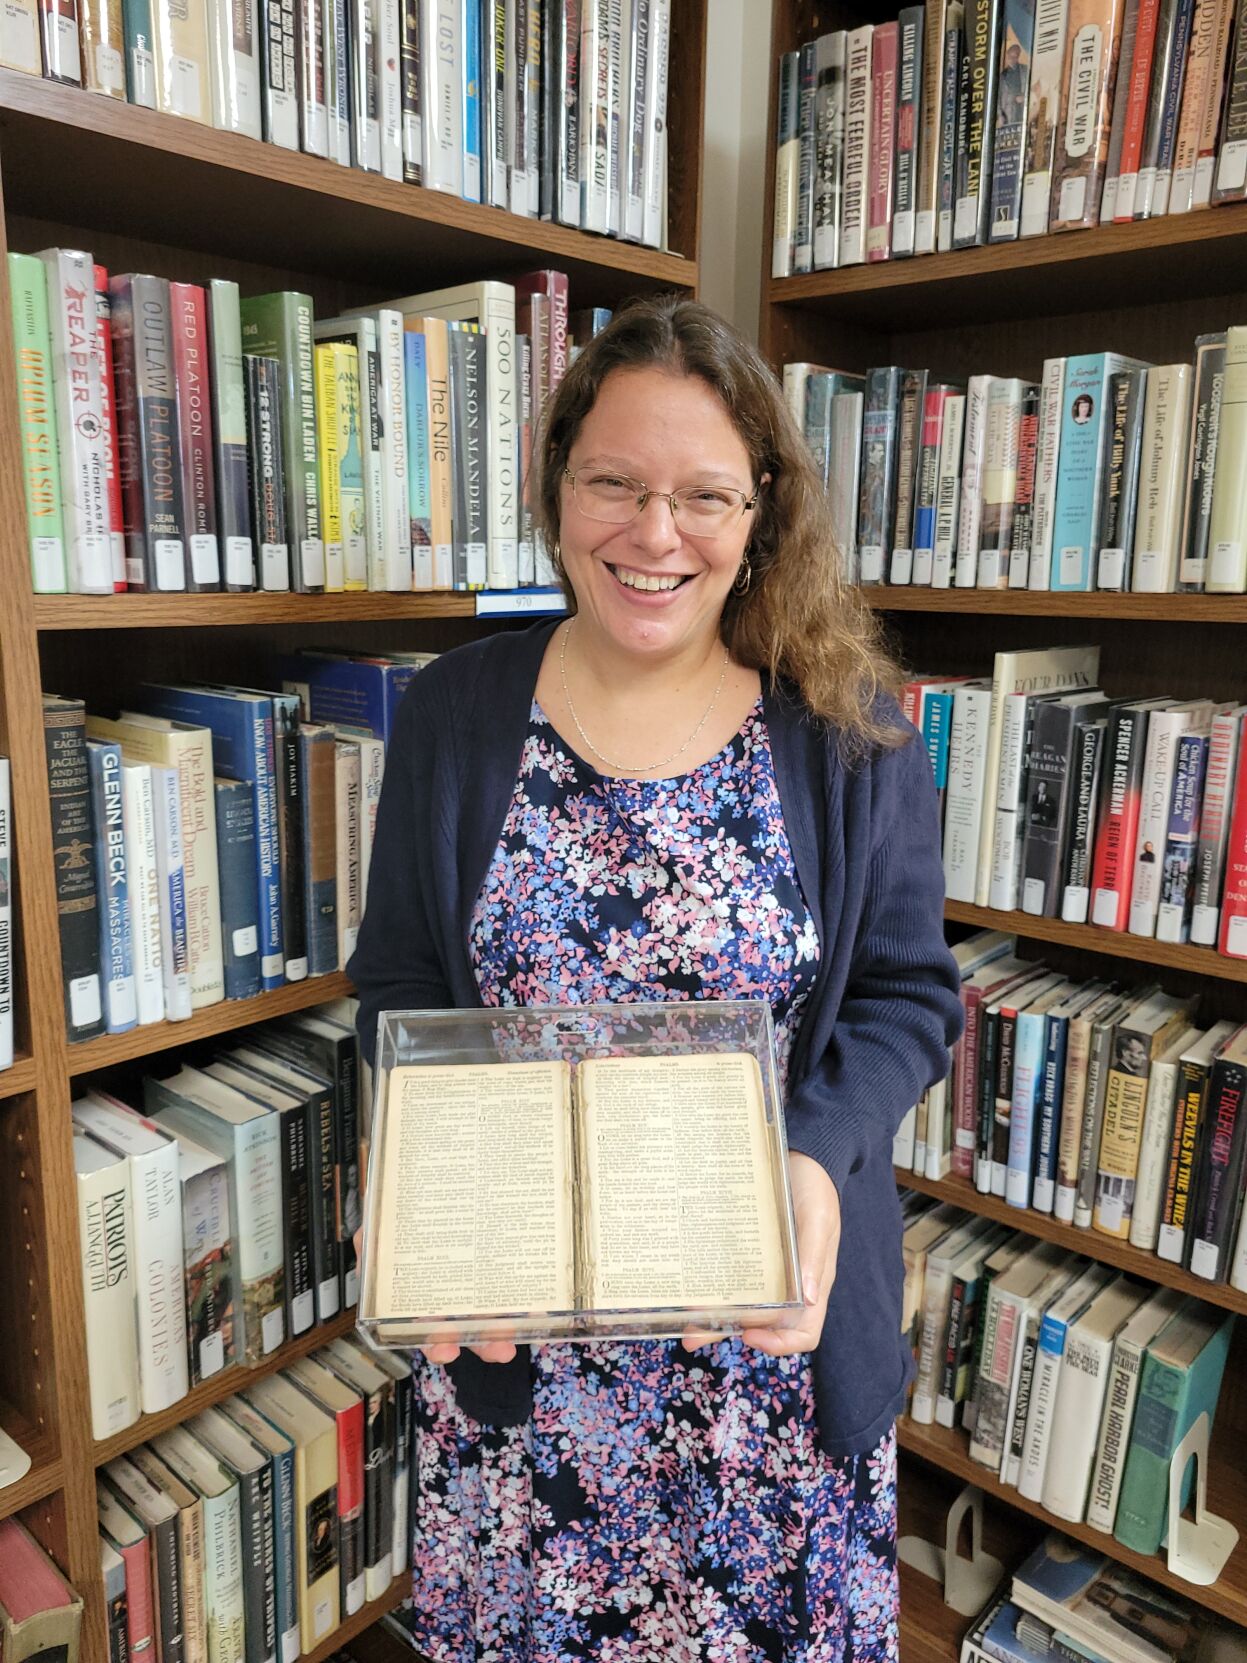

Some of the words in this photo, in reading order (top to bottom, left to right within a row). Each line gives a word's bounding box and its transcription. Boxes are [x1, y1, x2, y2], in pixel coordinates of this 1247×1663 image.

[440, 14, 454, 67] LOST
[496, 4, 506, 45] JOKER
[902, 24, 916, 61] KILLING
[974, 1, 989, 61] STORM
[496, 48, 506, 73] ONE
[635, 18, 649, 94] Ordinary
[851, 46, 868, 71] THE
[1080, 35, 1096, 64] THE
[902, 64, 915, 101] LINCOLN
[961, 56, 971, 87] CARL
[971, 67, 985, 113] OVER
[1076, 70, 1092, 110] CIVIL
[826, 97, 835, 132] JON
[849, 76, 867, 116] MOST
[880, 70, 894, 147] UNCERTAIN
[634, 101, 646, 135] Dog
[969, 120, 983, 153] THE
[1072, 115, 1088, 146] WAR
[846, 120, 865, 181] FEARFUL
[878, 150, 890, 195] GLORY
[844, 182, 862, 232] ORDEAL
[184, 301, 197, 339] RED
[66, 296, 90, 403] REAPER
[89, 330, 98, 359] THE
[143, 301, 169, 393] OUTLAW
[298, 306, 314, 391] COUNTDOWN
[186, 348, 203, 437] PLATOON
[369, 357, 378, 404] AMERICA
[431, 375, 448, 414] The
[465, 348, 479, 429] NELSON
[1049, 365, 1061, 399] CIVIL
[1117, 382, 1130, 404] The
[301, 395, 315, 419] BIN
[1047, 401, 1059, 427] WAR
[1115, 406, 1127, 427] Life
[149, 404, 174, 502] PLATOON
[260, 411, 274, 478] STRONG
[302, 422, 317, 463] LADEN
[434, 421, 450, 462] Nile
[498, 389, 514, 526] NATIONS
[1044, 432, 1056, 483] FATHERS
[92, 452, 104, 521] NICHOLAS
[195, 448, 206, 498] CLINTON
[304, 472, 319, 505] CHRIS
[468, 436, 481, 535] MANDELA
[941, 476, 955, 509] GENERAL
[155, 512, 175, 524] SEAN
[938, 526, 951, 543] HILL
[254, 718, 267, 749] KNOW
[930, 702, 942, 733] JAMES
[192, 745, 204, 768] The
[951, 722, 963, 775] HEIRS
[961, 708, 978, 792] KENNEDY
[1081, 732, 1096, 776] GEORGE
[1116, 719, 1133, 761] SPENCER
[1180, 744, 1190, 761] Soul
[1188, 744, 1201, 775] Chicken
[52, 769, 74, 778] AND
[168, 776, 177, 796] BEN
[256, 752, 268, 784] ABOUT
[1185, 776, 1199, 796] Soup
[102, 753, 121, 826] GLENN
[1079, 779, 1092, 804] AND
[1110, 763, 1129, 816] ACKERMAN
[1174, 772, 1186, 815] AMERICA
[196, 806, 208, 832] and
[258, 787, 270, 837] AMERICAN
[347, 782, 358, 856] MEASURING
[1076, 806, 1090, 841] LAURA
[1107, 820, 1122, 848] REIGN
[108, 830, 126, 888] BECK
[183, 832, 199, 879] Dream
[260, 839, 273, 879] HISTORY
[1106, 851, 1117, 863] OF
[199, 886, 210, 915] Bruce
[348, 858, 359, 913] AMERICA
[320, 1100, 332, 1153] REBELS
[1105, 1076, 1120, 1137] CITADEL
[1118, 1080, 1144, 1144] LINCOLN'S
[1182, 1092, 1201, 1150] WEEVILS
[1212, 1087, 1241, 1167] FIREFIGHT
[322, 1164, 334, 1192] SEA
[1180, 1150, 1192, 1165] IN
[144, 1167, 160, 1222] TAYLOR
[1176, 1167, 1192, 1192] THE
[104, 1188, 129, 1288] PATRIOTS
[148, 1259, 169, 1368] COLONIES
[170, 1264, 185, 1345] AMERICAN
[1038, 1364, 1053, 1403] MIRACLE
[1111, 1370, 1131, 1411] PEARL
[1034, 1418, 1044, 1435] THE
[1036, 1405, 1046, 1416] IN
[1102, 1410, 1123, 1463] HARBOR
